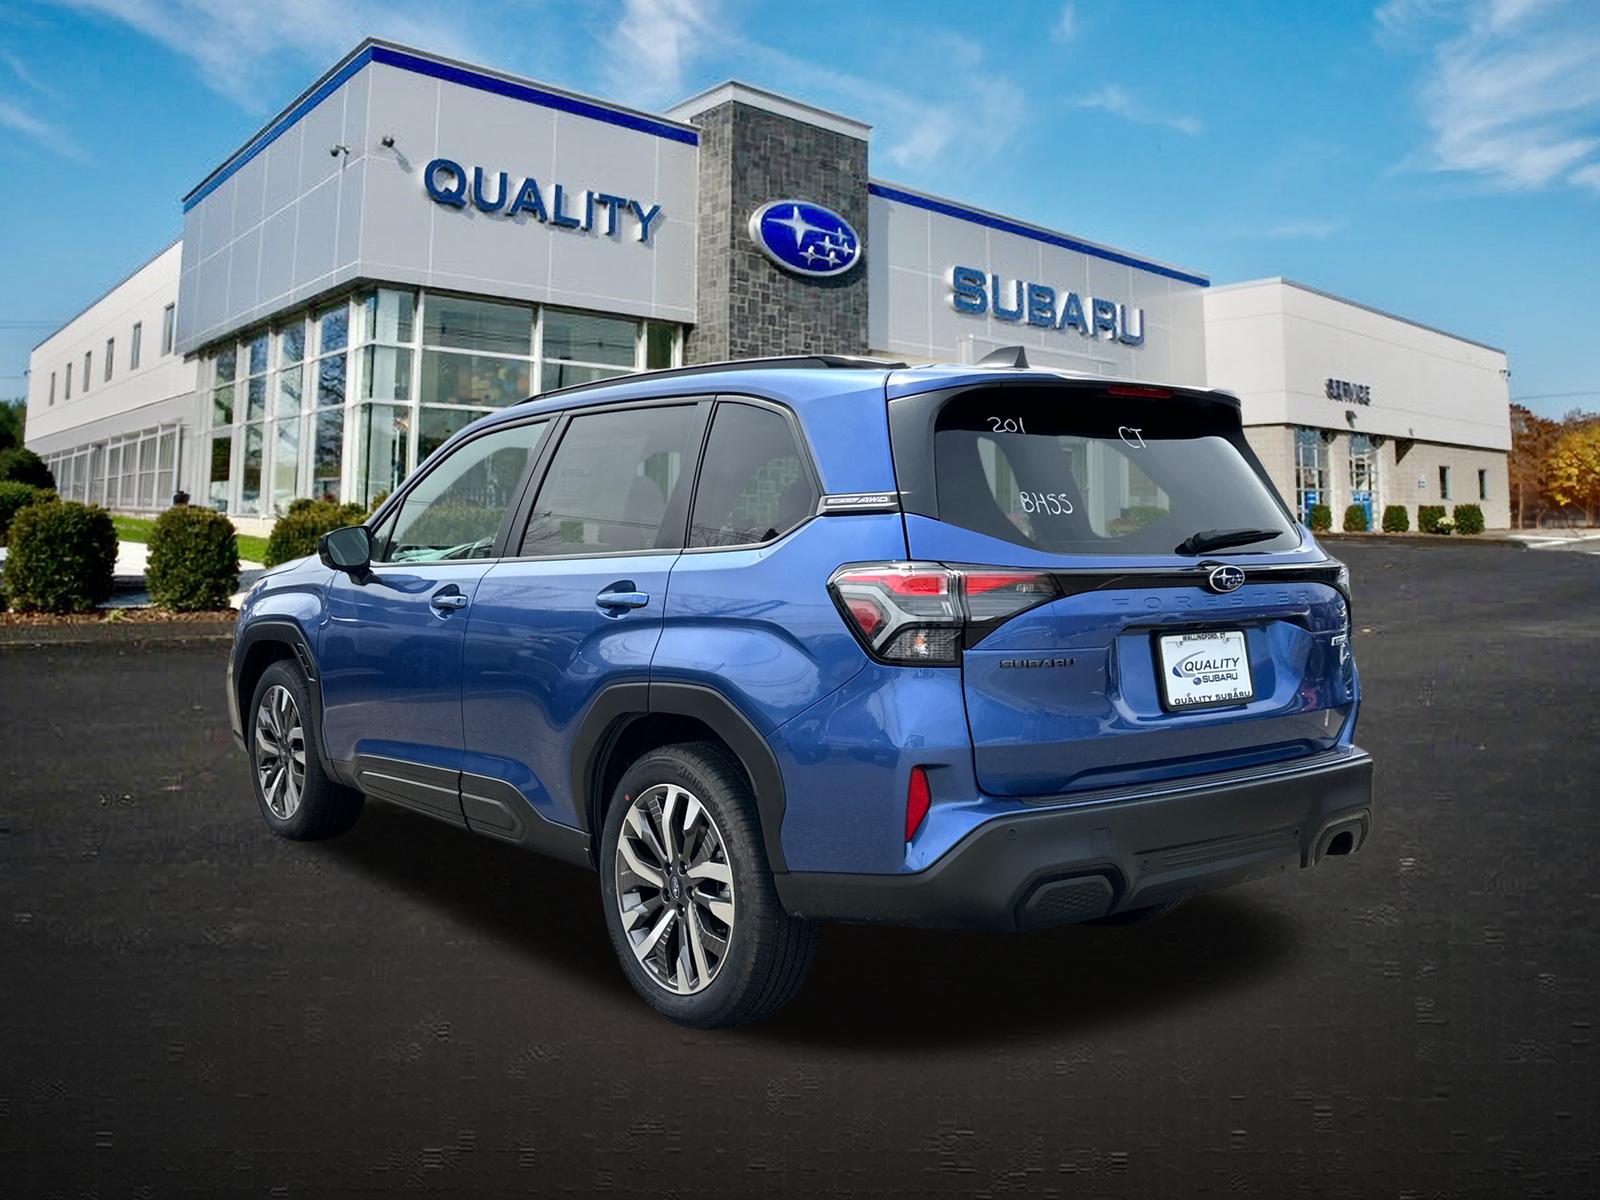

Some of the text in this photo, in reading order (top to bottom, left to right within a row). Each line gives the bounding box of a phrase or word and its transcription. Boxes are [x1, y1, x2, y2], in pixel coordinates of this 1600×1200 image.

[423, 158, 662, 243] QUALITY
[951, 265, 1145, 346] SUBARU
[1324, 378, 1371, 406] SERVICE
[987, 417, 1026, 434] 201
[1118, 426, 1147, 448] CT
[1112, 591, 1310, 608] FORESTER
[1000, 658, 1075, 669] SUBARU
[1184, 657, 1240, 672] QUALITY
[1203, 673, 1238, 683] SUBARU
[1174, 690, 1251, 705] QUALITY SUBARU
